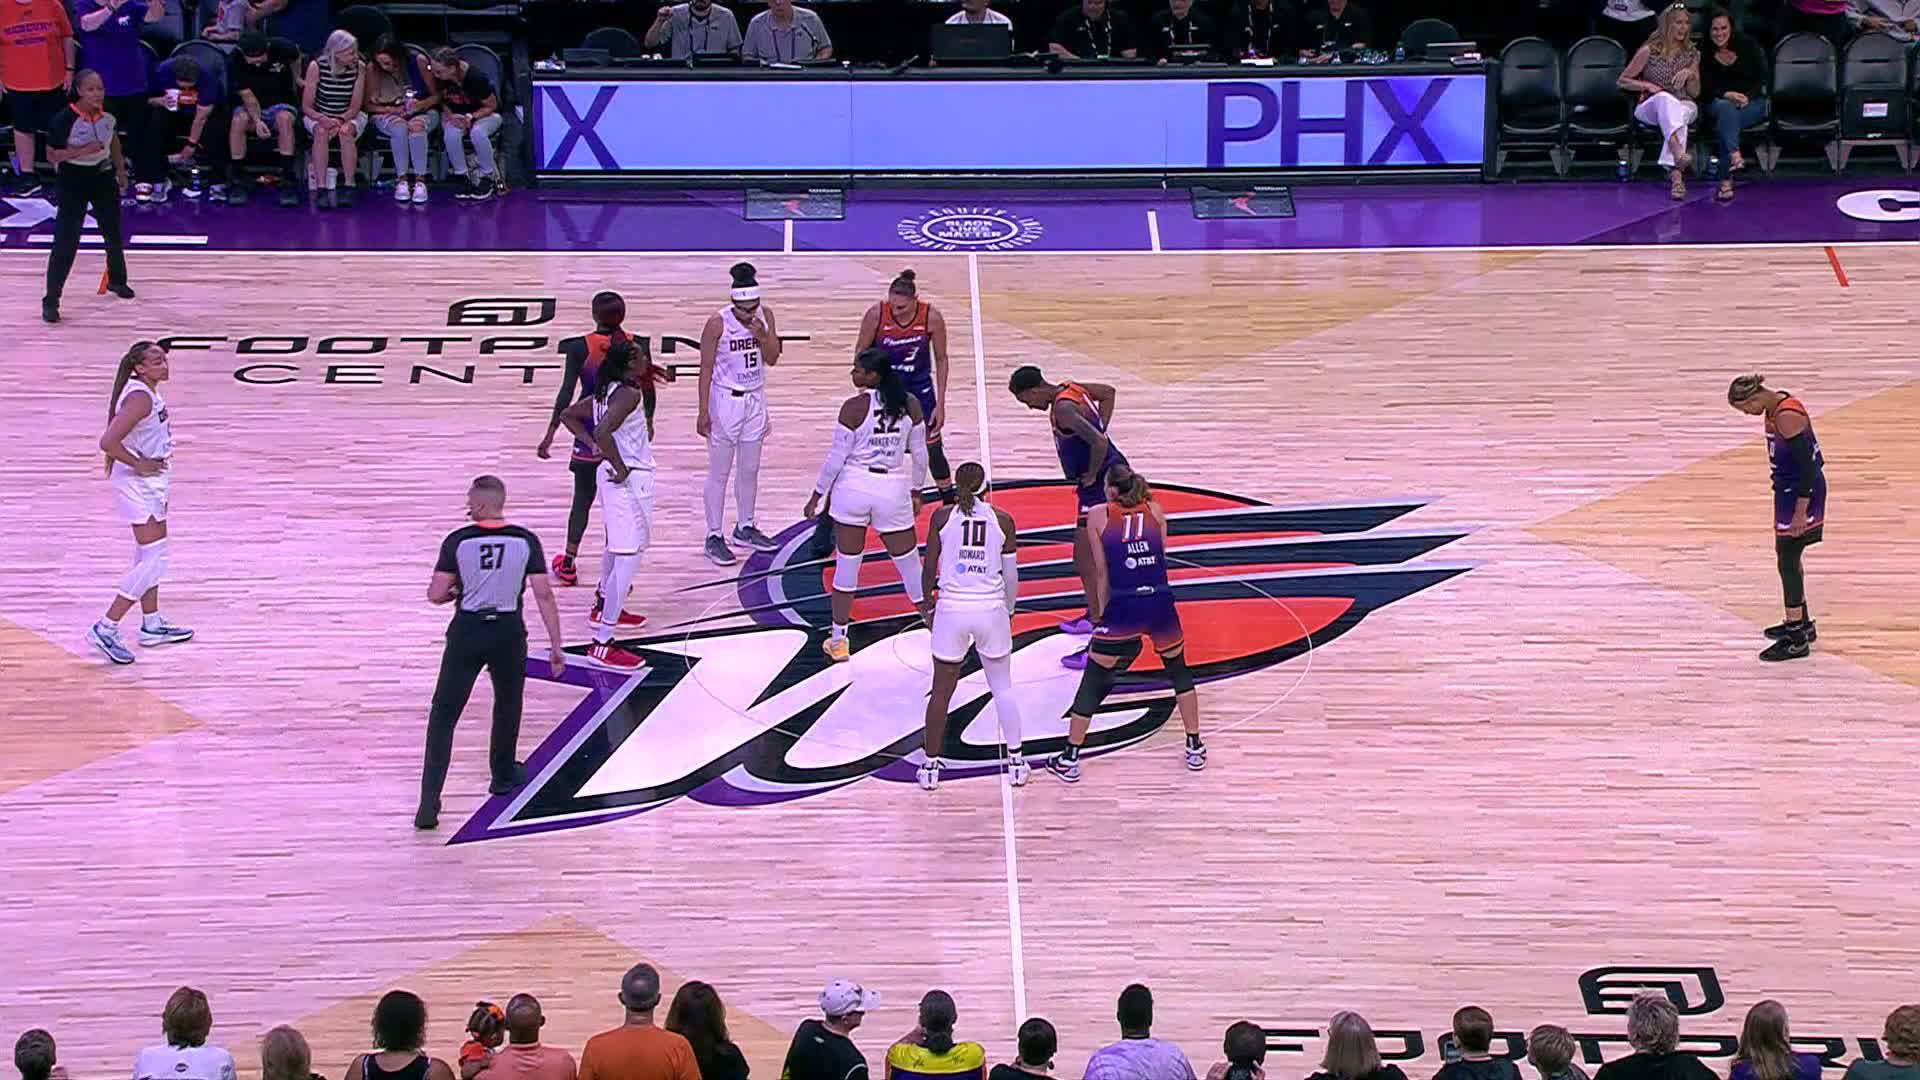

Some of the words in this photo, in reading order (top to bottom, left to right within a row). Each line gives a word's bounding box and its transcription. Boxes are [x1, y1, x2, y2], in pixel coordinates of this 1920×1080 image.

[1206, 77, 1454, 168] PHX
[730, 337, 761, 352] DREA
[744, 351, 757, 369] 15
[961, 519, 987, 546] 10
[958, 549, 986, 561] HOWARD
[1127, 541, 1150, 554] ALLEN
[479, 543, 505, 570] 27
[1137, 555, 1156, 567] AT&T
[967, 564, 987, 574] AT&T
